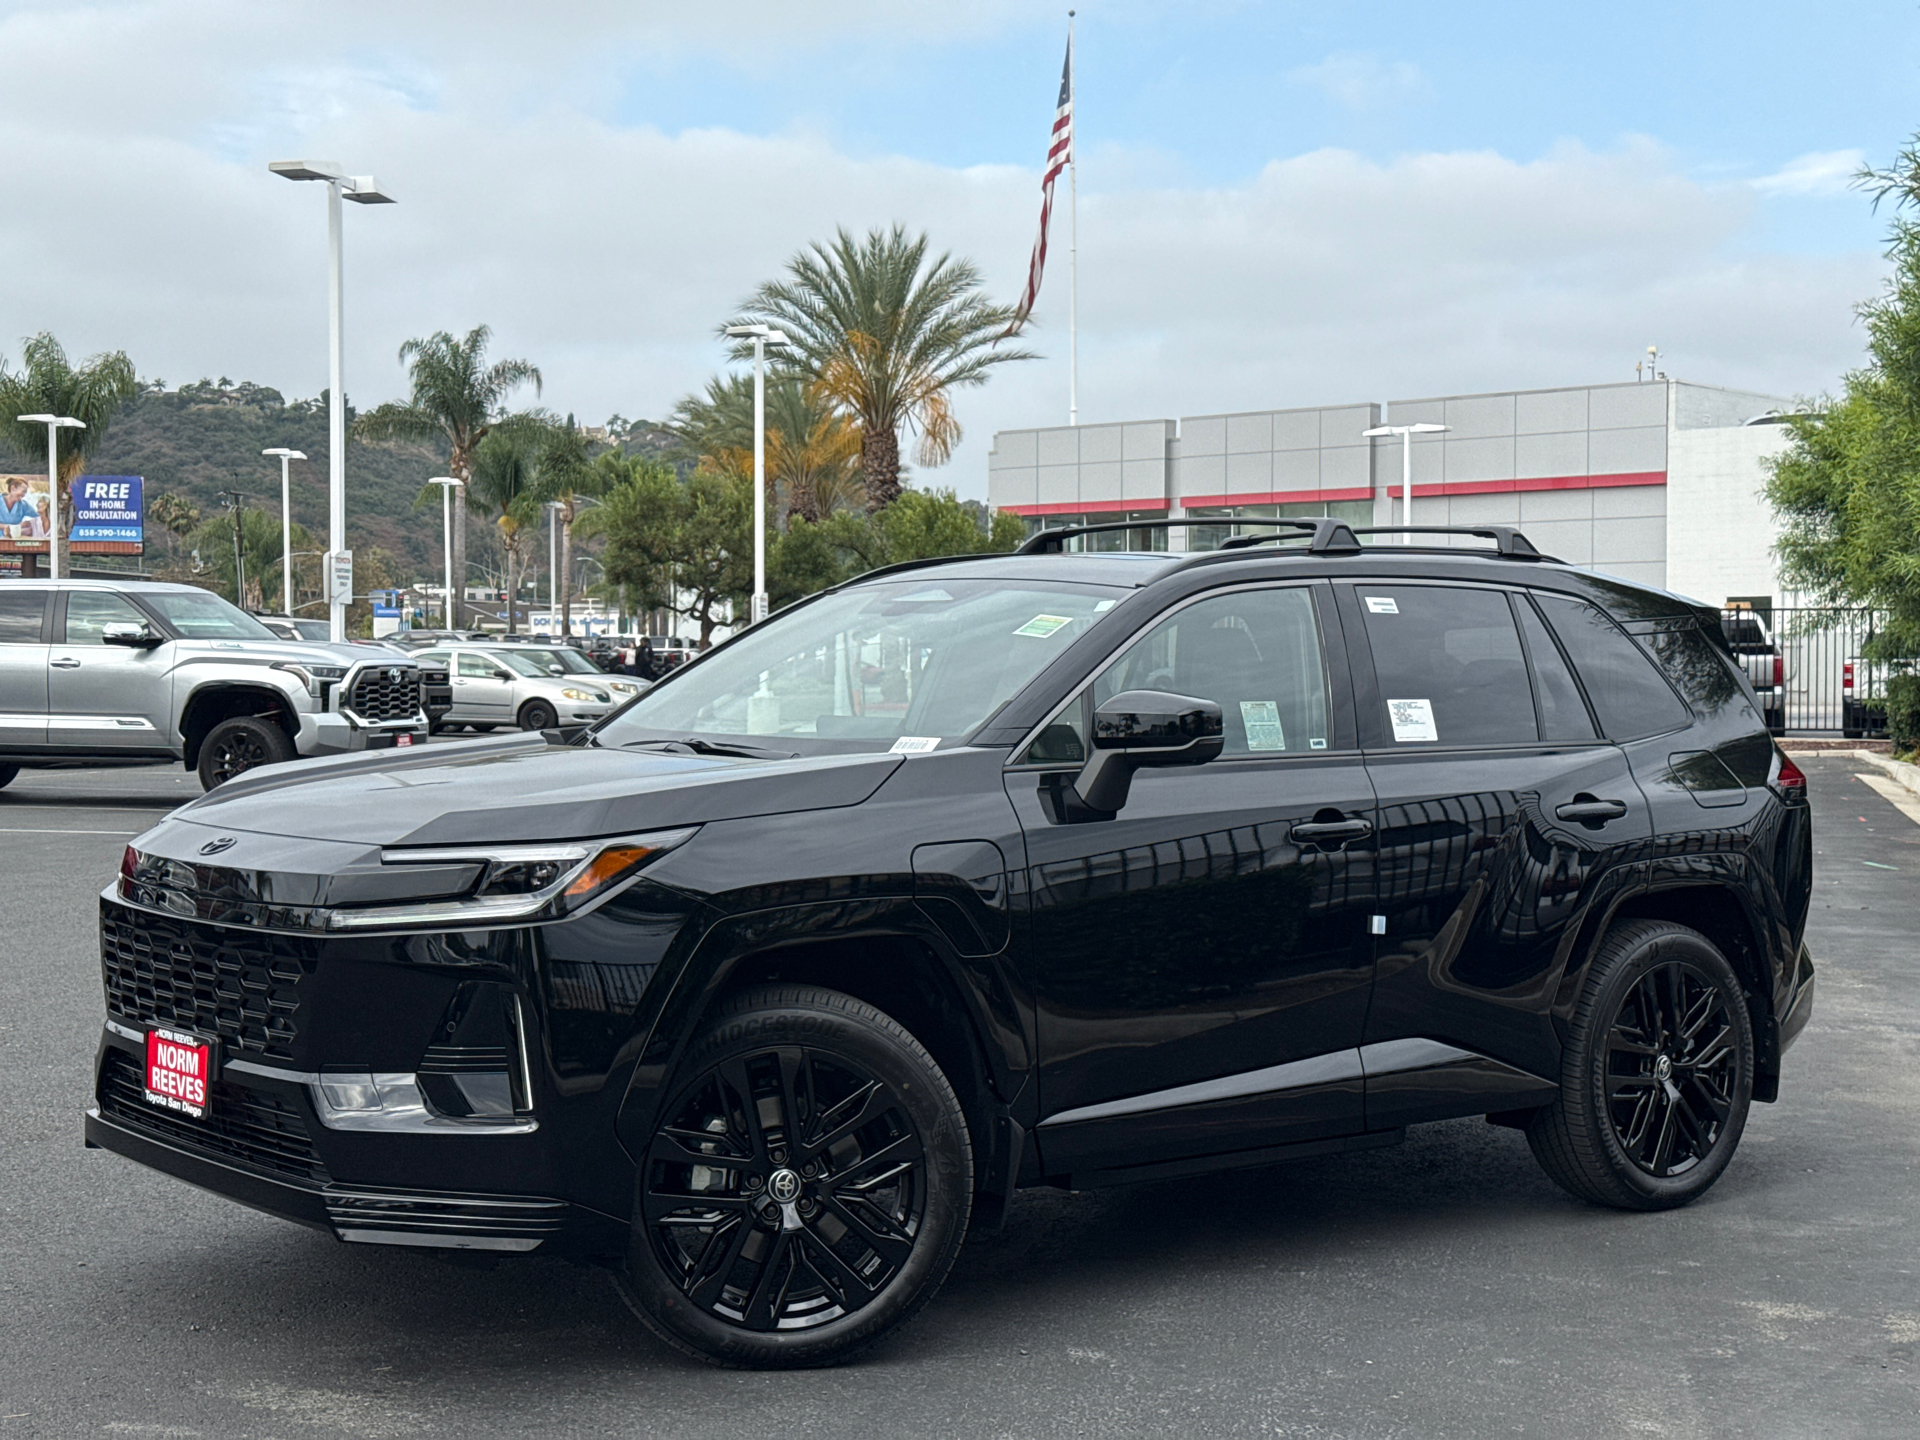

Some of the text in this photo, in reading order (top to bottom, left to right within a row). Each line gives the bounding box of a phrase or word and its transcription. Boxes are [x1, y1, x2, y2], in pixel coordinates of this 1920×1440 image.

[84, 482, 130, 499] FREE
[89, 500, 126, 510] IN-HOME
[78, 510, 137, 520] CONSULTATION
[78, 528, 137, 537] 858-290-1466
[158, 1028, 194, 1046] NORM REEVES
[157, 1042, 199, 1076] NORM
[152, 1066, 204, 1103] REEVES
[145, 1089, 202, 1117] Toyota San Diego
